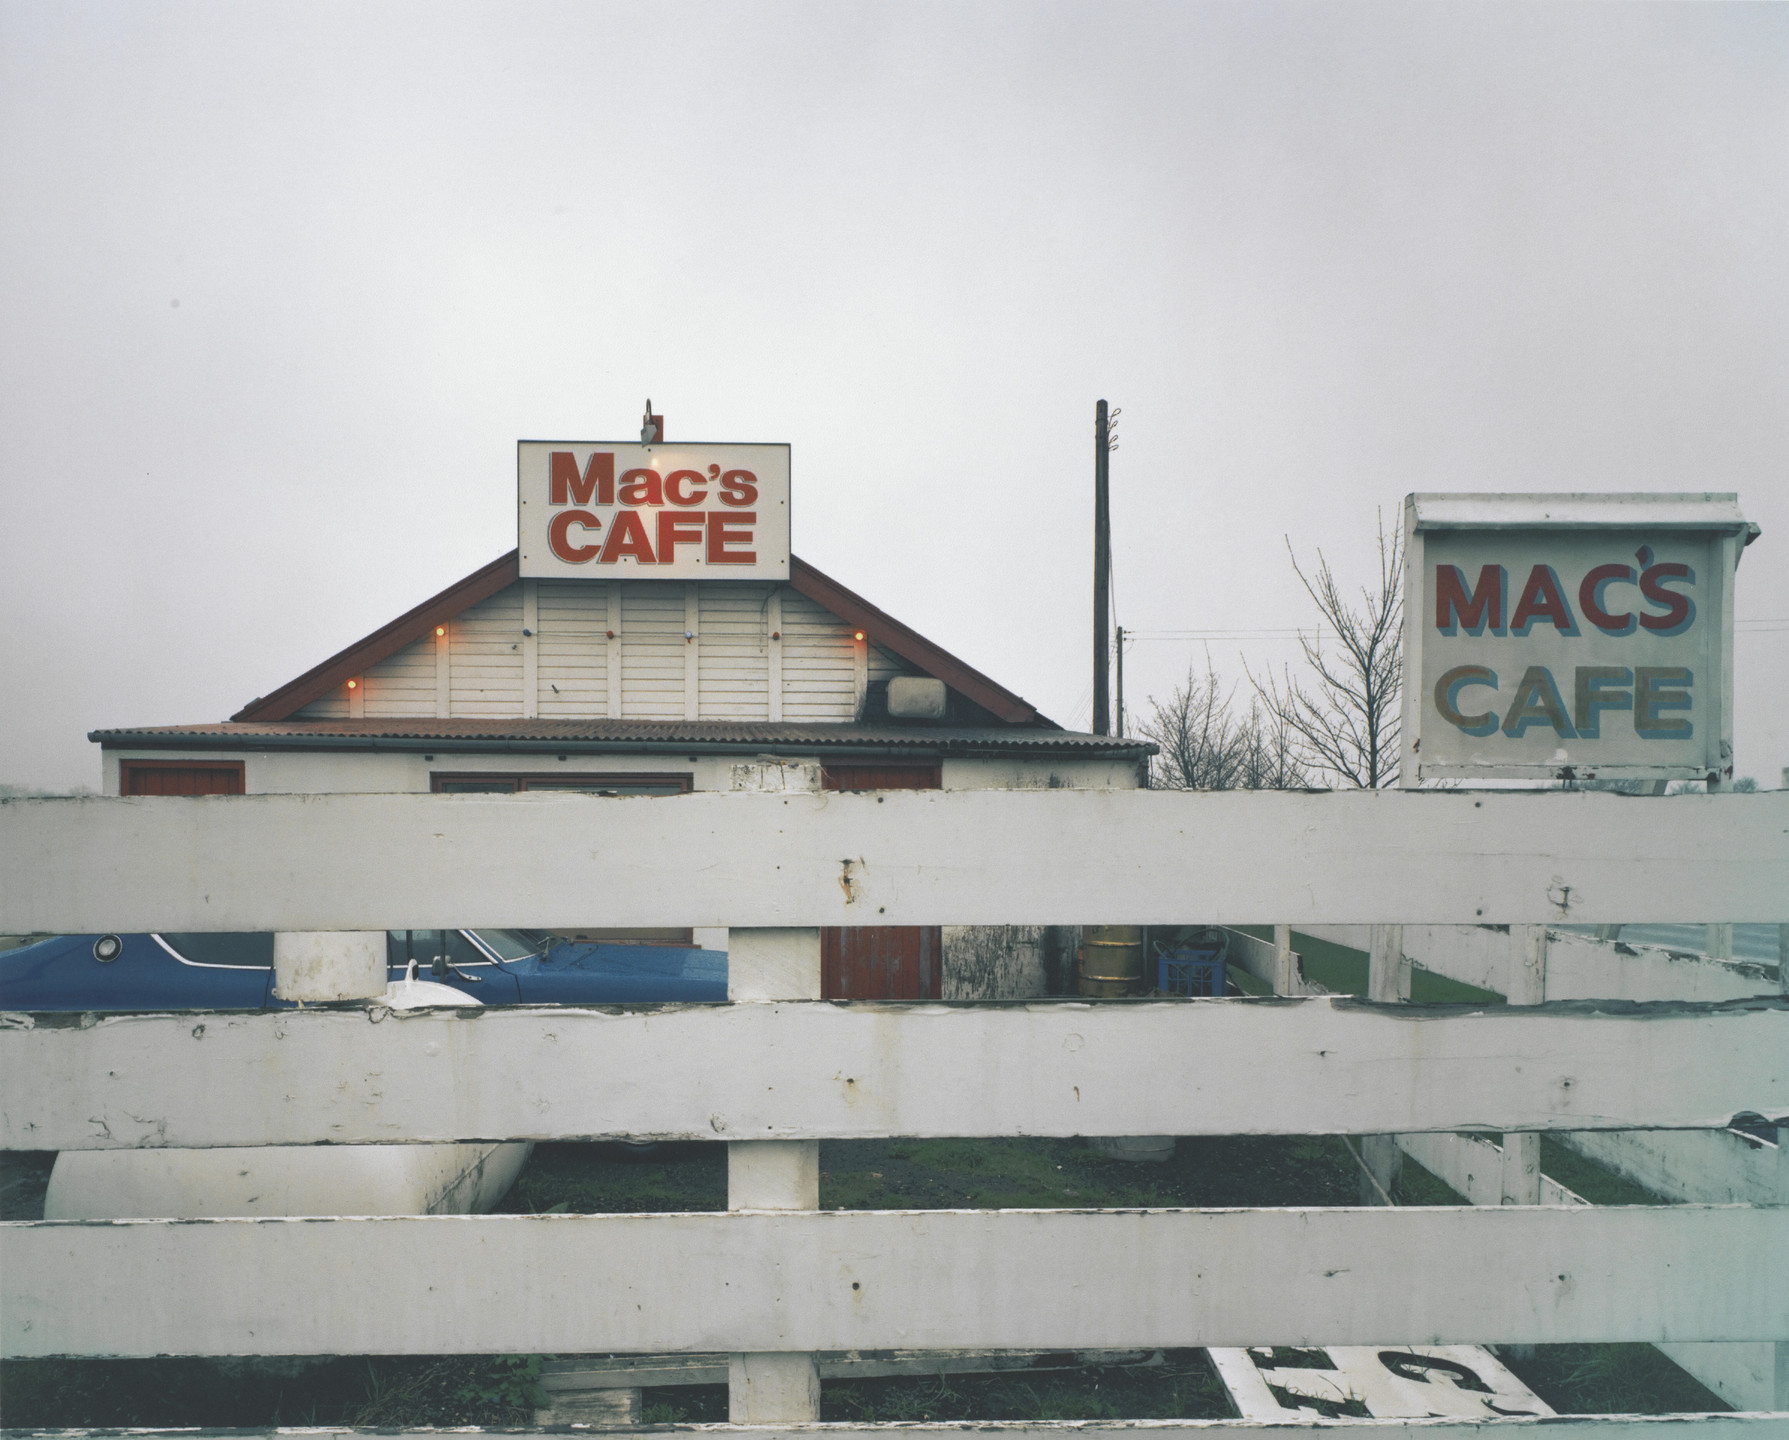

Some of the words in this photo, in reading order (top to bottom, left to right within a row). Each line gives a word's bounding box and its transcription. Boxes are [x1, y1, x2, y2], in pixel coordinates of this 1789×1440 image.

[549, 451, 758, 507] Mac's
[547, 509, 757, 565] CAFE
[1436, 545, 1697, 637] MAC'S
[1434, 665, 1694, 740] CAFE
